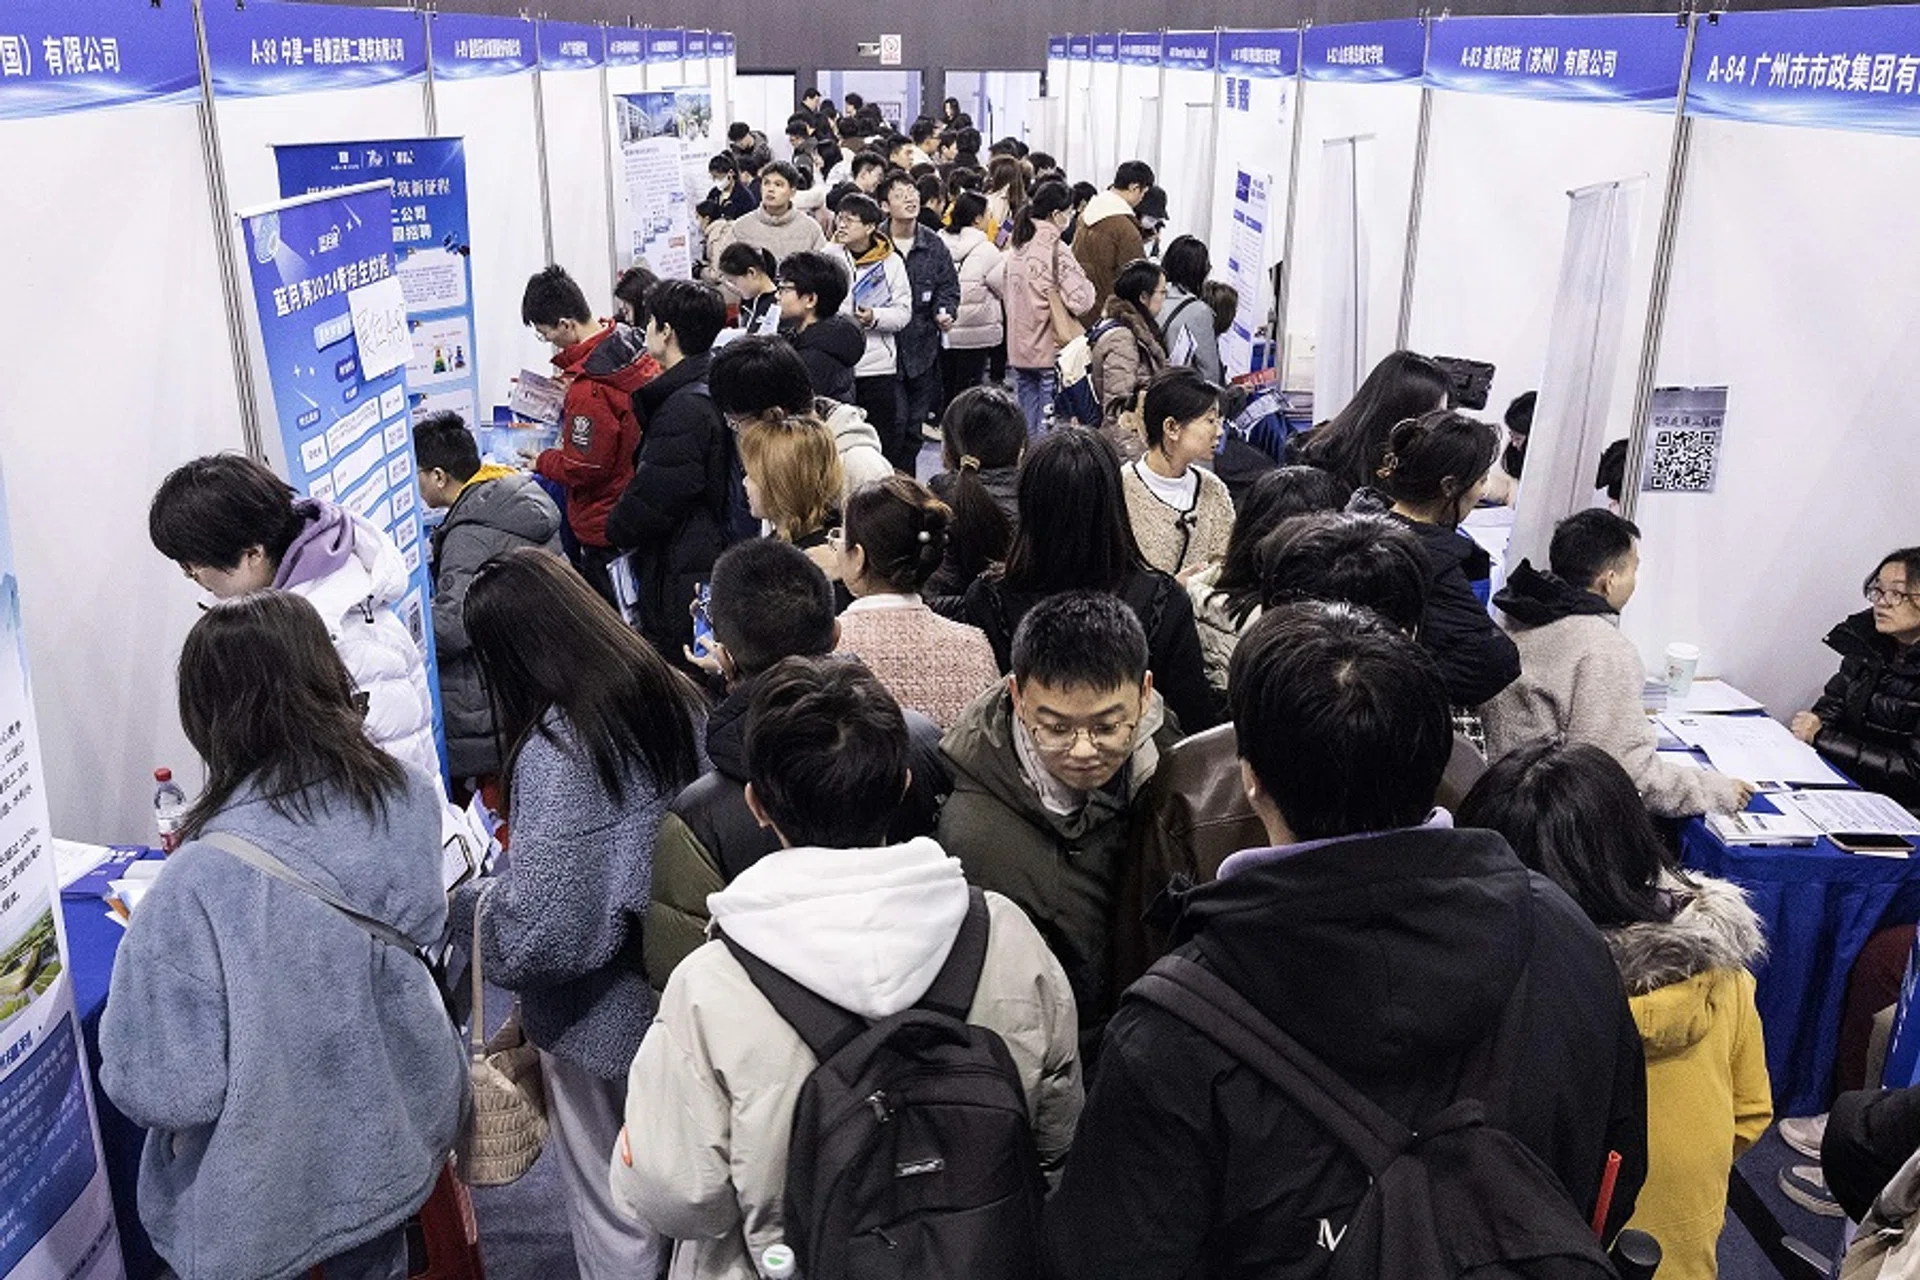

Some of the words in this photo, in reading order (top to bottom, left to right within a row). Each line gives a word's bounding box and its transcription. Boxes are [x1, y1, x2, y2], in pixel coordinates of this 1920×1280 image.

[1706, 55, 1747, 83] A-84
[1750, 52, 1920, 94] 广州市市政集团有
